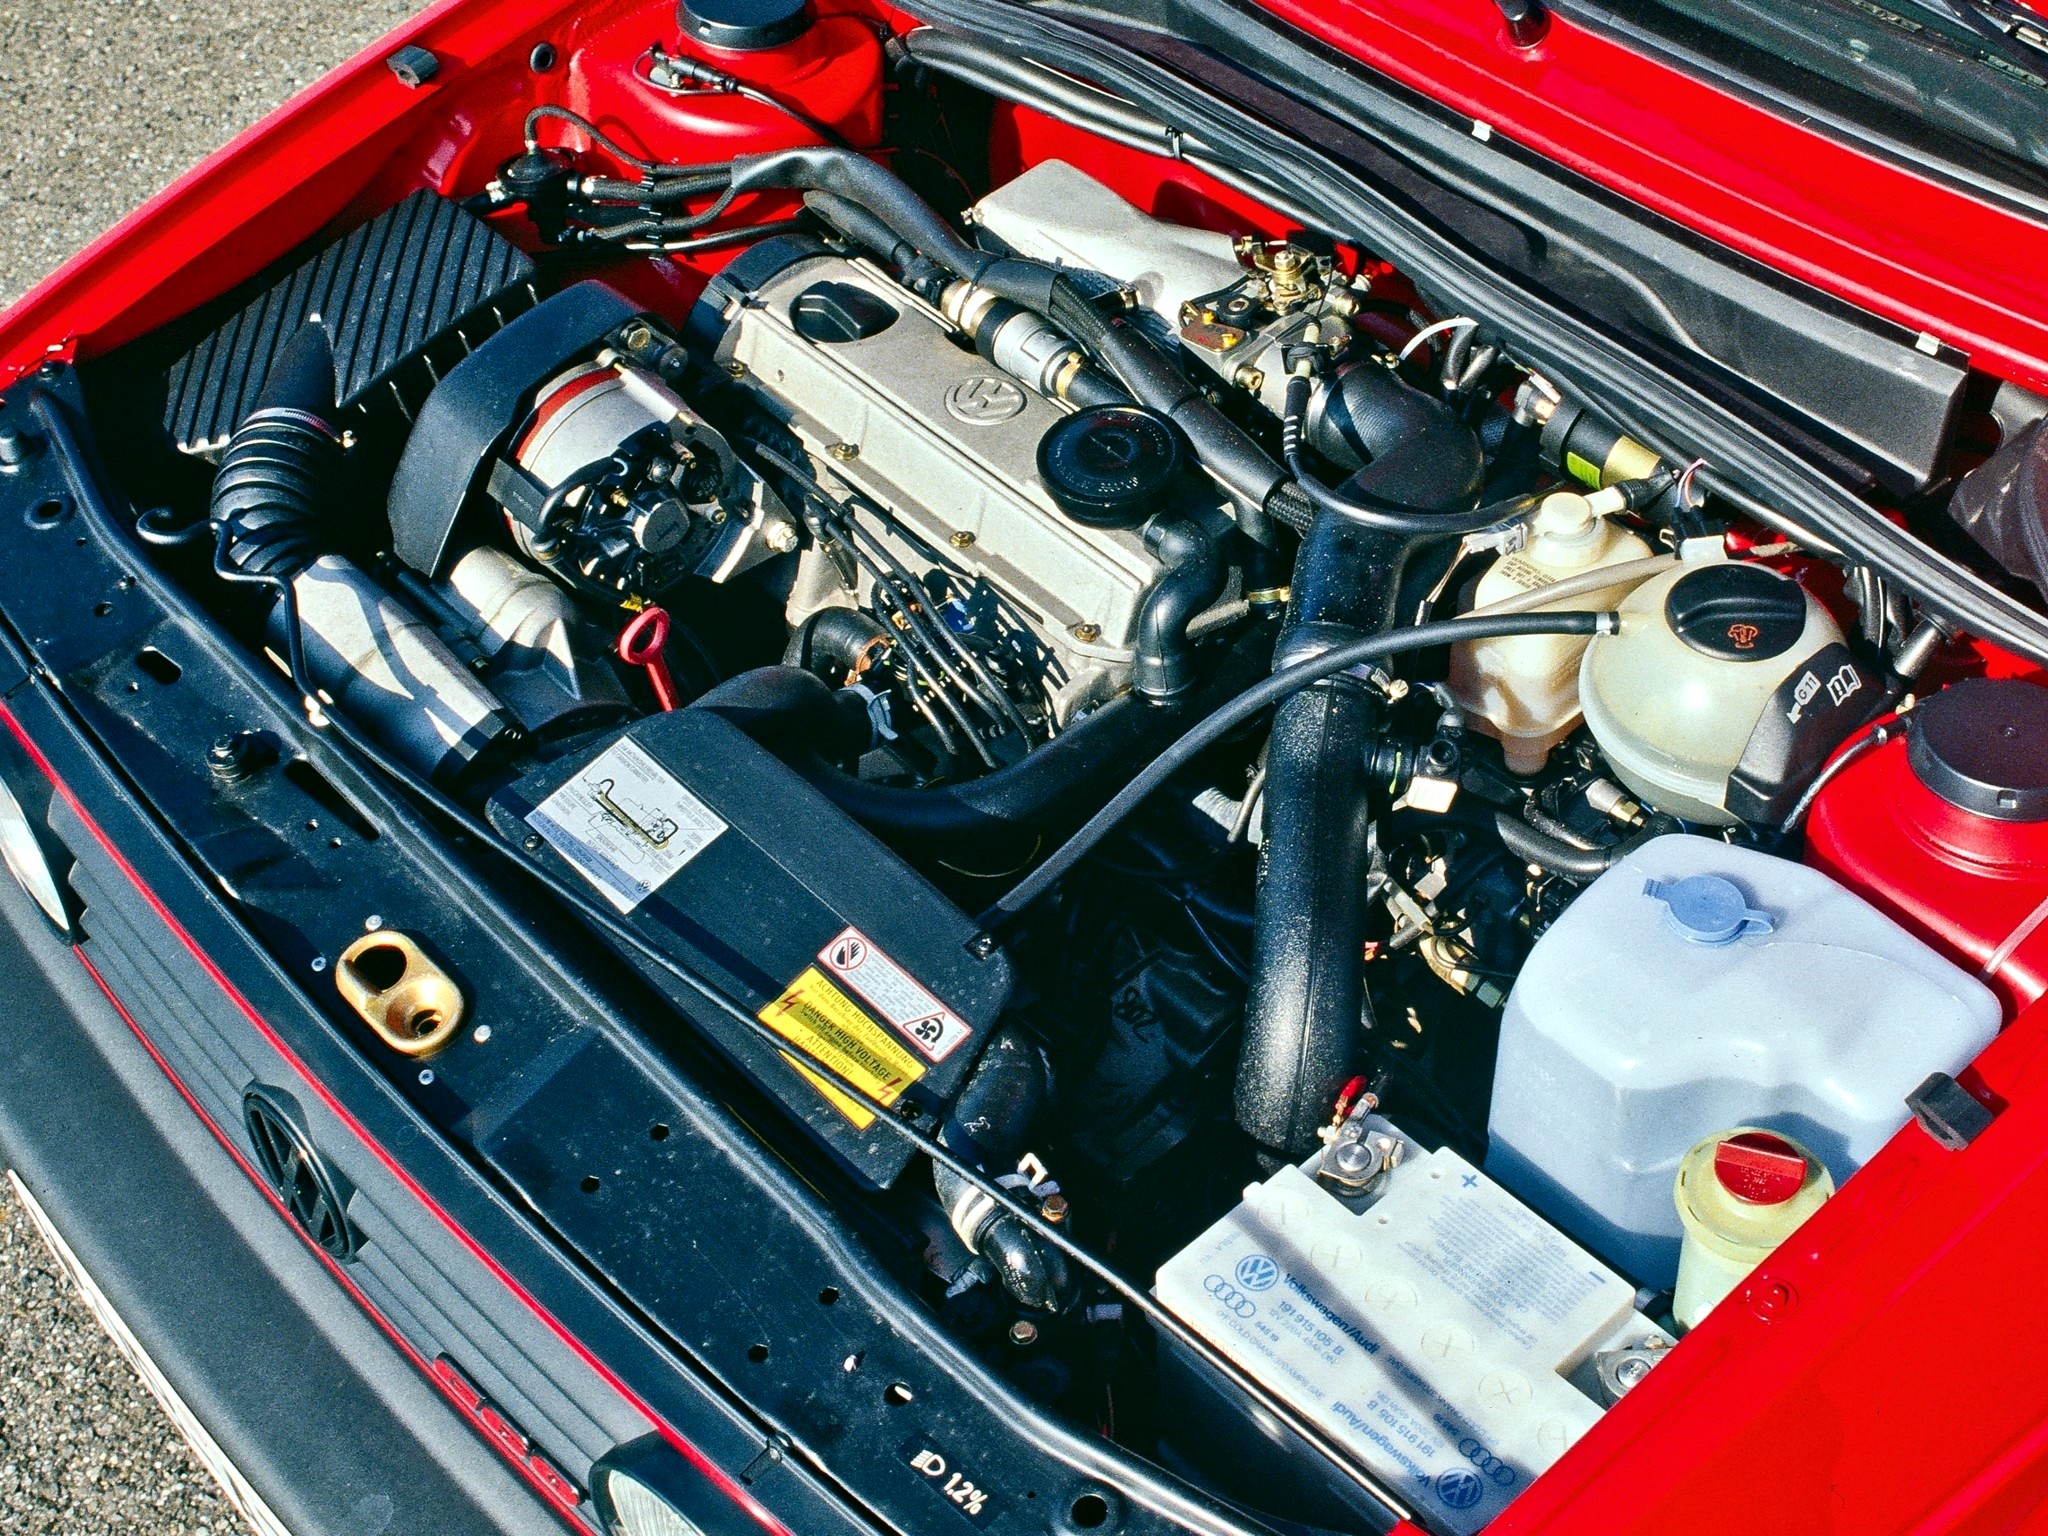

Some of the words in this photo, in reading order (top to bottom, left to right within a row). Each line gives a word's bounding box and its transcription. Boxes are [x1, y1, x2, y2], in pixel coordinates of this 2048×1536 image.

[1798, 689, 1807, 700] G
[802, 999, 837, 1031] DANGER
[833, 1027, 857, 1049] HIGH
[853, 1045, 892, 1081] VOLTAGE
[815, 978, 853, 1013] ACHTUNG
[850, 1010, 915, 1069] HOCHSPANNUNG
[805, 1033, 853, 1078] ATTENTION!
[1275, 1298, 1298, 1318] 191
[1293, 1312, 1316, 1332] 915
[1311, 1327, 1334, 1347] 105
[1331, 1343, 1346, 1356] B
[1279, 1270, 1380, 1358] Volkswagen/Audi
[1364, 1398, 1379, 1411] B
[1376, 1407, 1399, 1428] 105
[1329, 1397, 1435, 1489] Volkswagen/Audi
[1395, 1422, 1419, 1444] 915
[1415, 1439, 1437, 1458] 191
[944, 1472, 988, 1515] 1.2%
